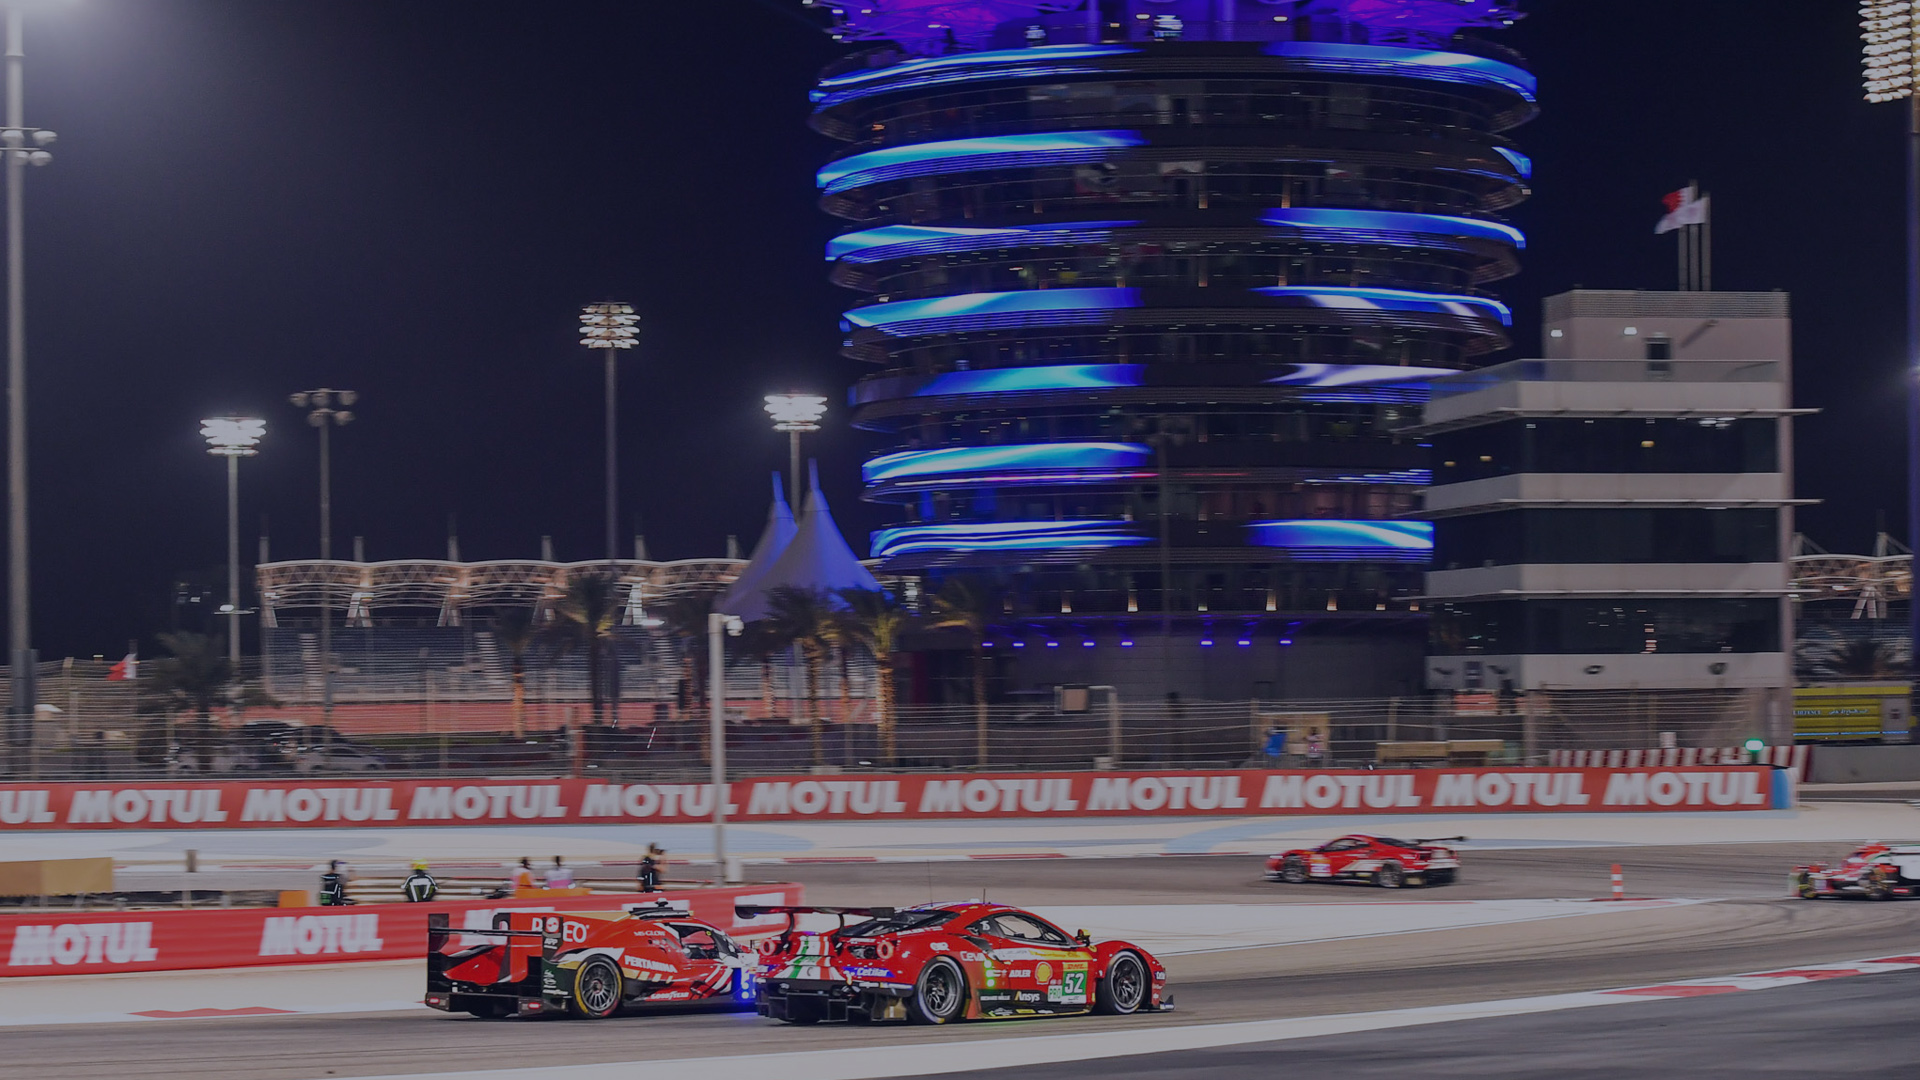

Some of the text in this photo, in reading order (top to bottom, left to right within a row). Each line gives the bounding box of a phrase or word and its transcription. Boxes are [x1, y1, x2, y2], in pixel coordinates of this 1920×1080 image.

[68, 789, 228, 823] MOTUL
[240, 787, 399, 822] MOTUL
[408, 785, 568, 819] MOTUL
[580, 784, 739, 817] MOTUL
[747, 781, 906, 814] MOTUL
[919, 779, 1078, 812] MOTUL
[1086, 776, 1247, 811] MOTUL
[1260, 774, 1421, 808] MOTUL
[1432, 772, 1590, 807] MOTUL
[1603, 772, 1765, 806] MOTUL
[8, 921, 158, 966] MOTUL
[259, 913, 384, 956] MOTUL
[1014, 990, 1041, 1003] Ansys
[1064, 971, 1085, 994] 52
